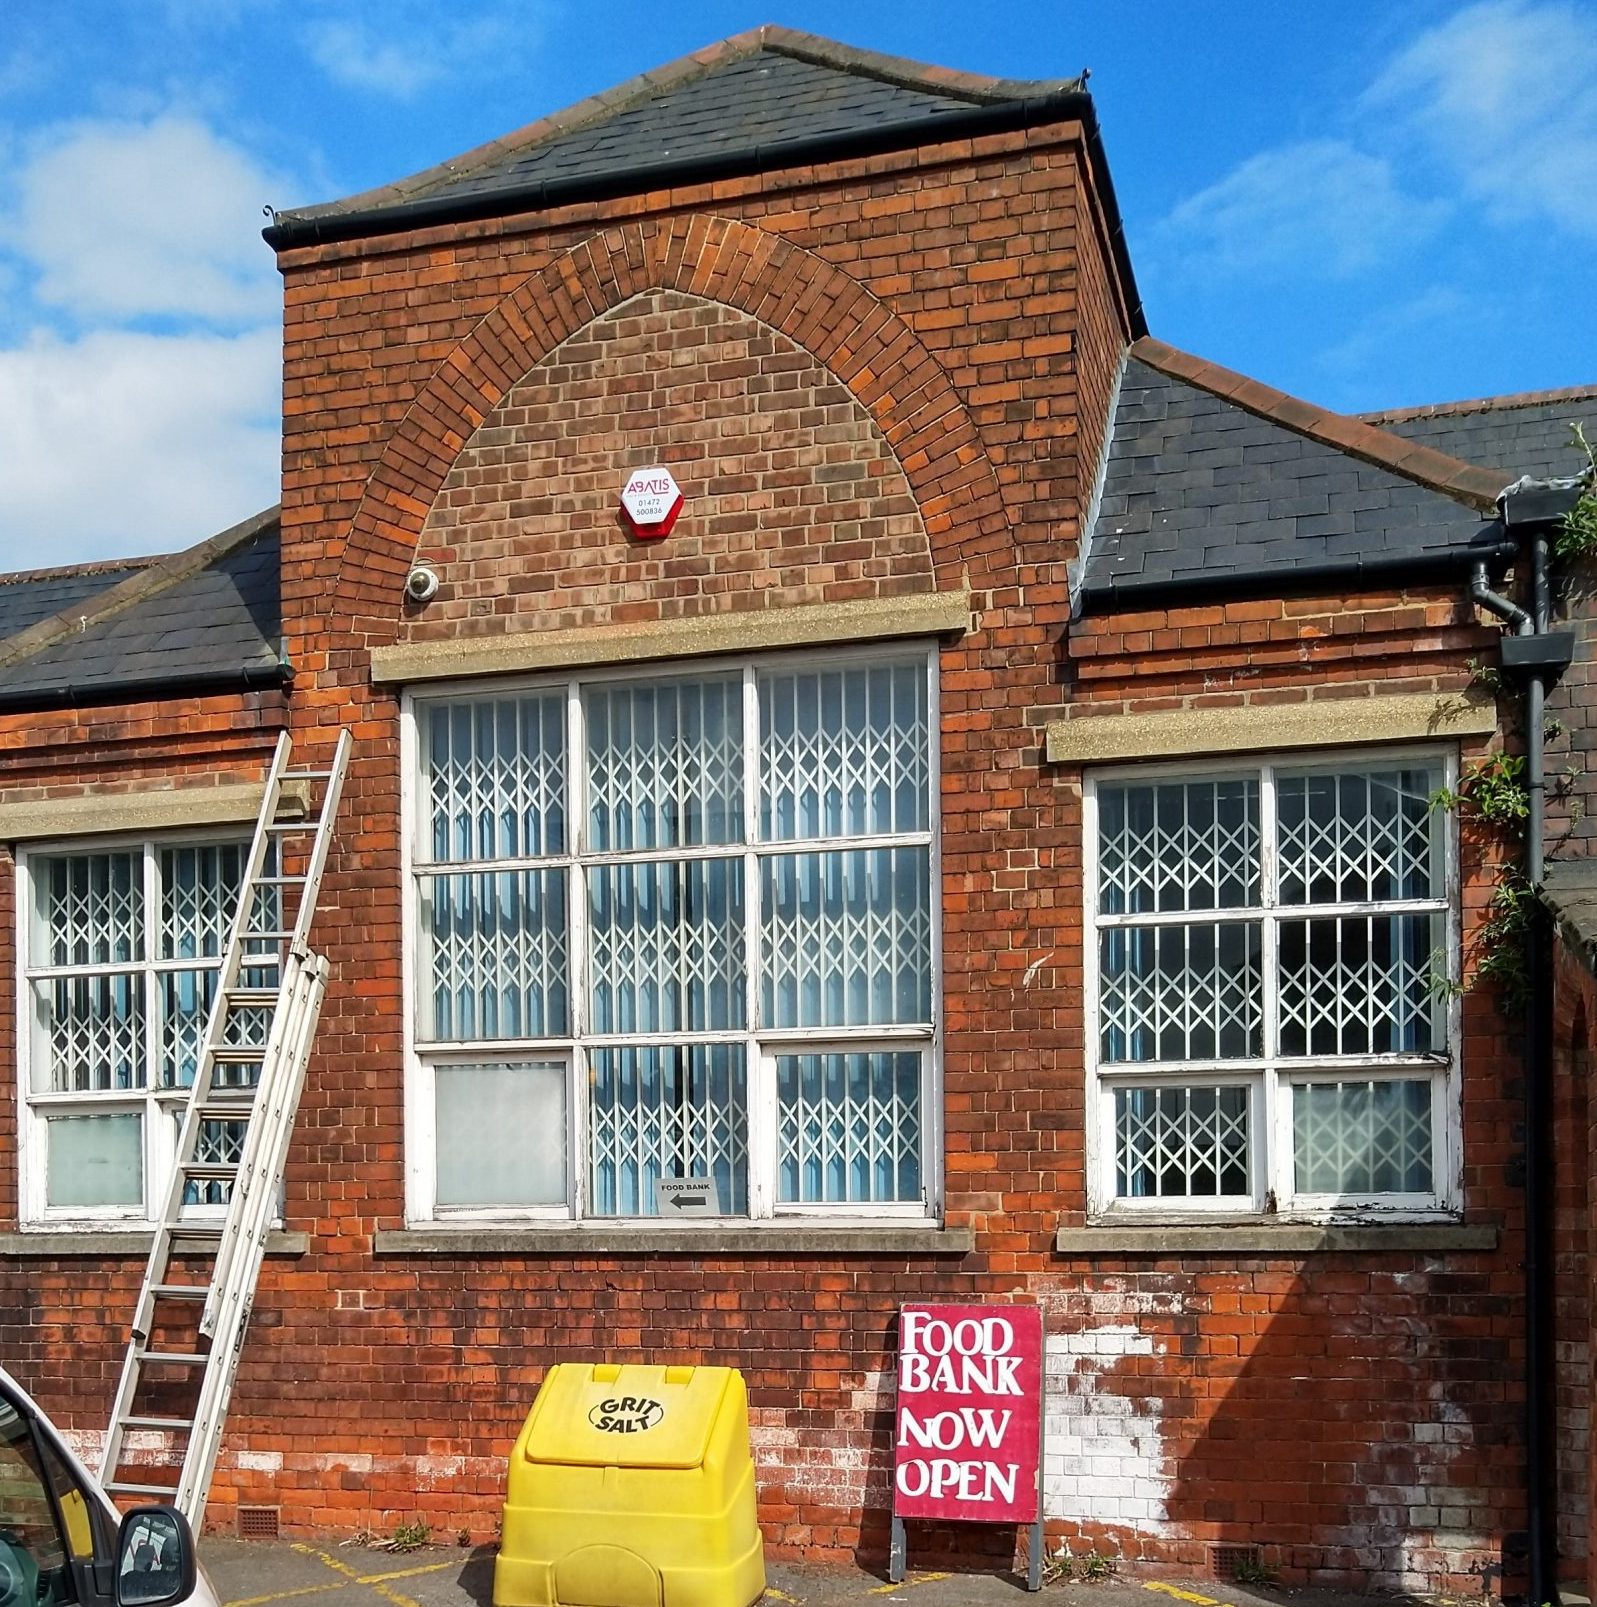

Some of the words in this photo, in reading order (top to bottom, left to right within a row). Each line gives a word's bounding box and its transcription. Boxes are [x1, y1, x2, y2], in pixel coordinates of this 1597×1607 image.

[627, 479, 670, 495] ABATIS
[636, 507, 663, 516] 500836
[638, 498, 660, 507] 01472
[686, 1183, 711, 1191] BANK
[900, 1311, 1014, 1357] FOOD
[899, 1353, 1025, 1396] BANK
[599, 1397, 661, 1415] GRIT
[594, 1415, 650, 1434] SALT
[896, 1406, 1013, 1451] NOW
[896, 1458, 1020, 1504] OPEN
